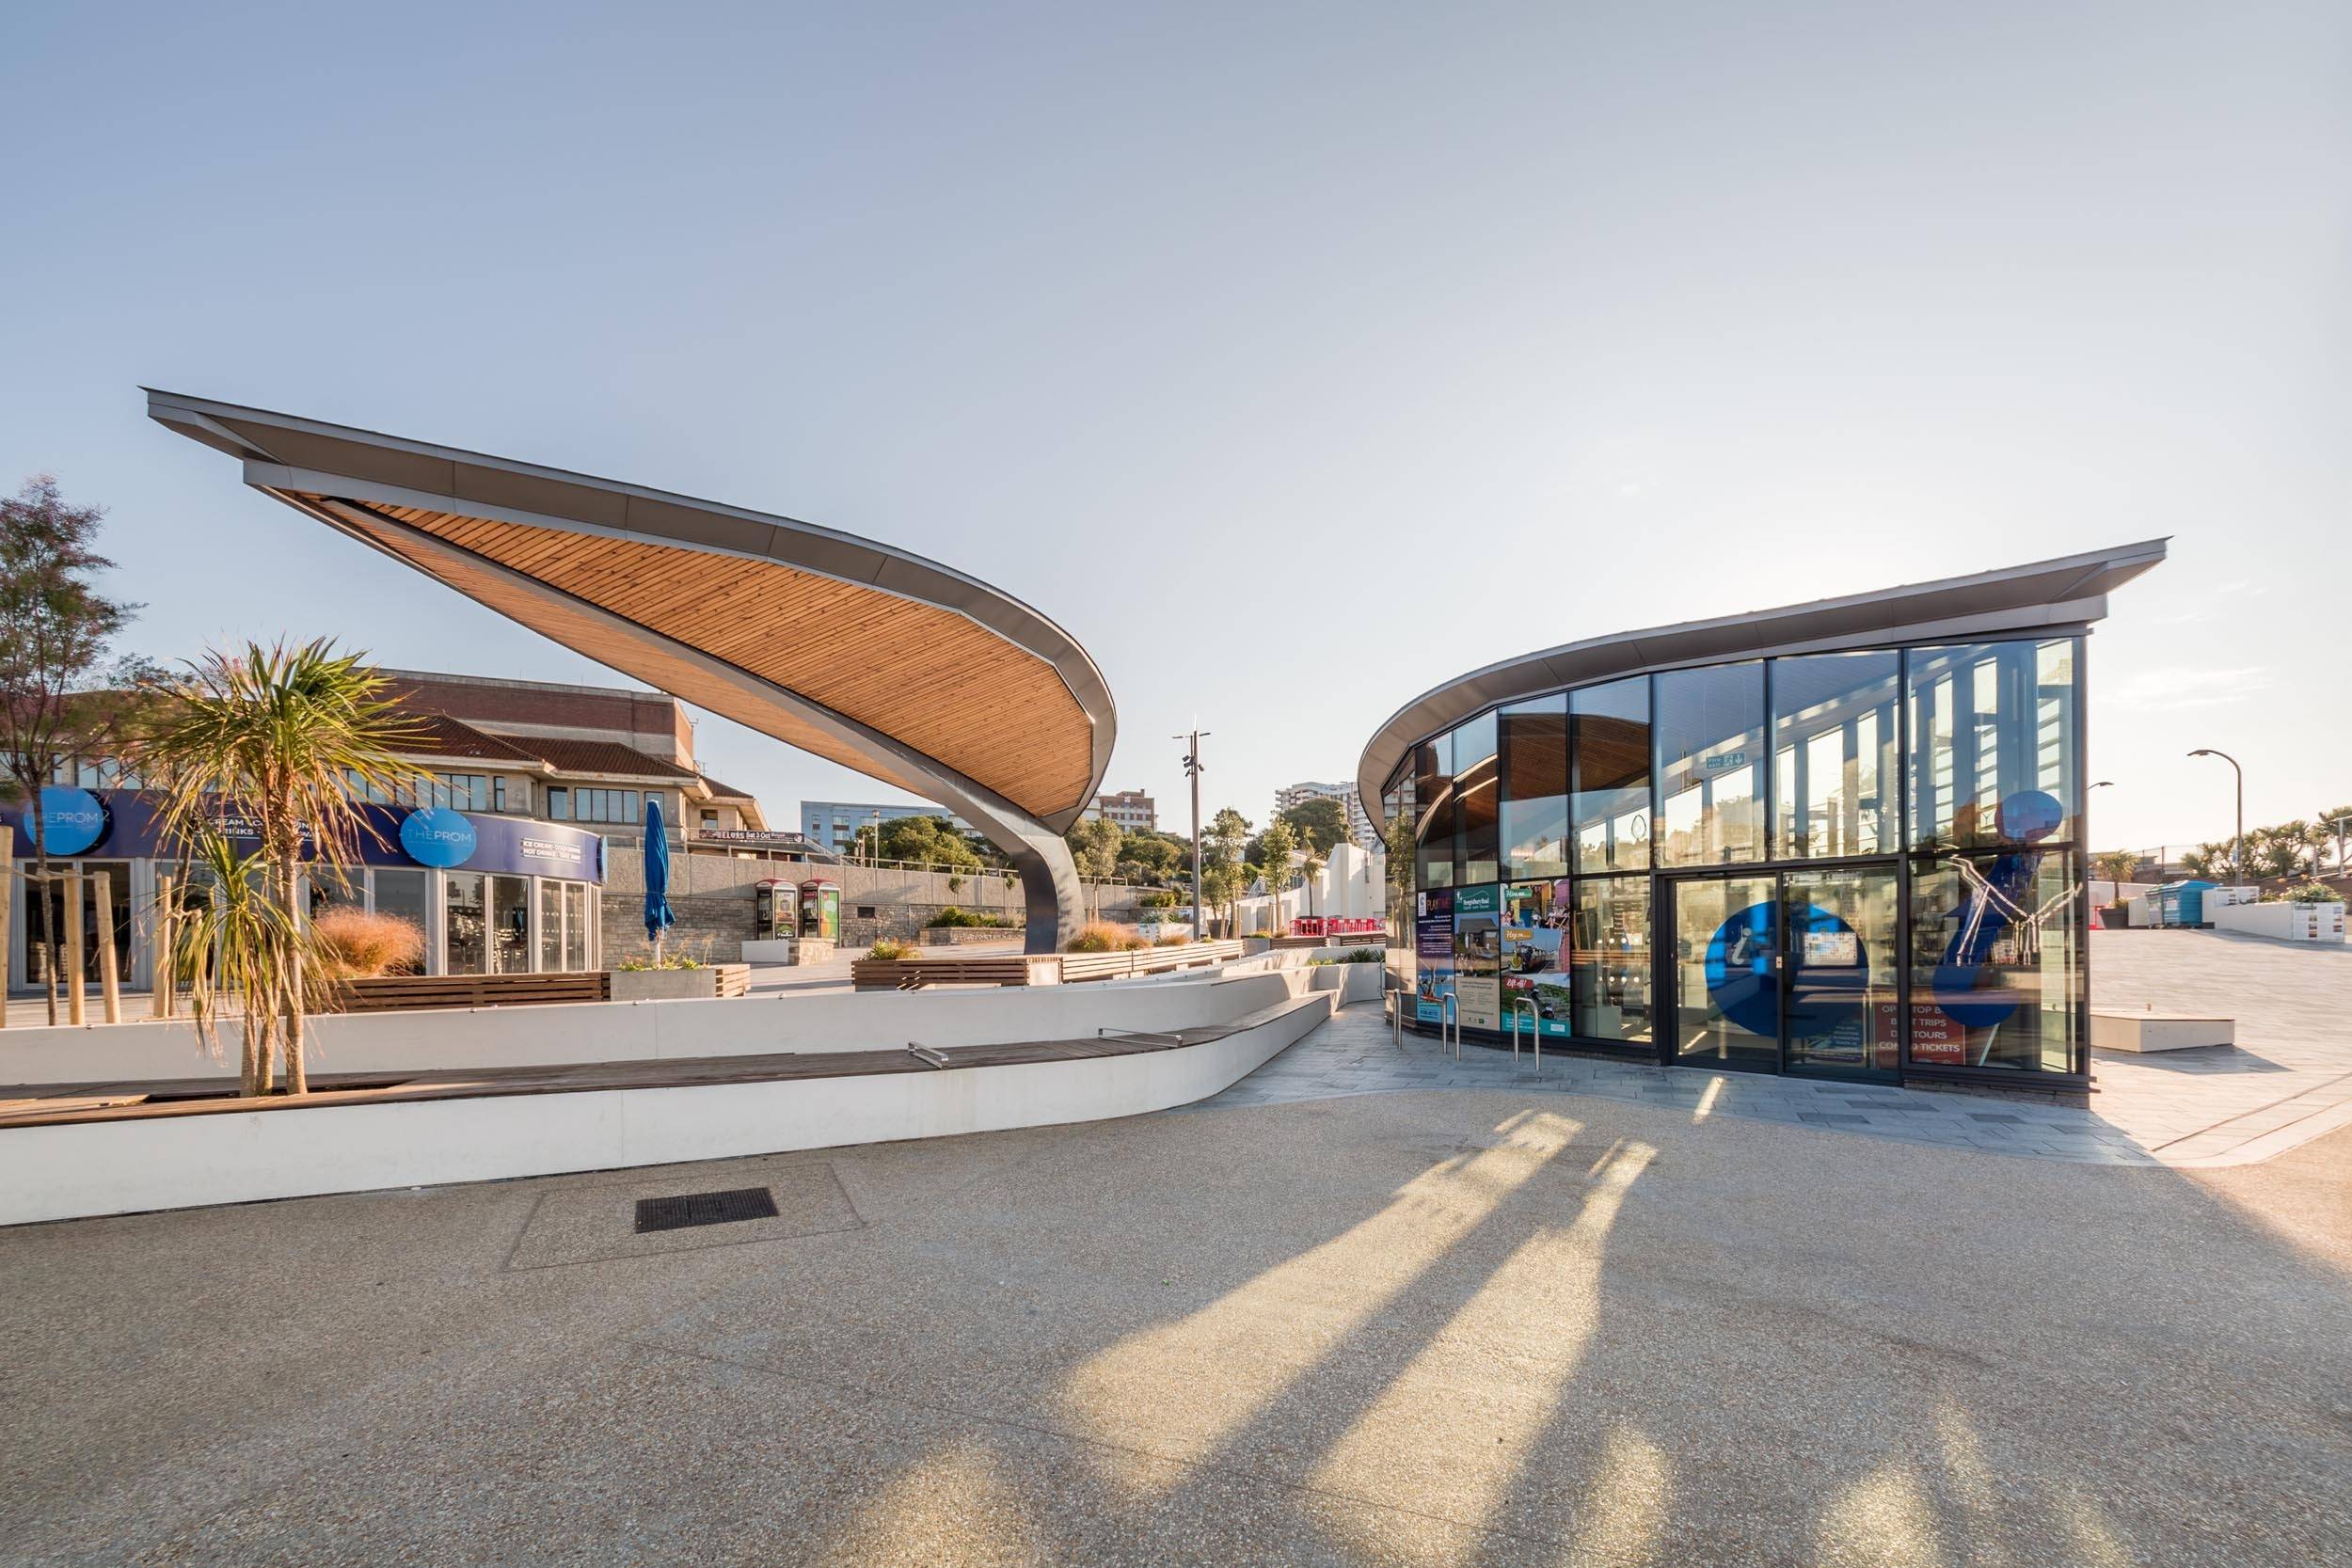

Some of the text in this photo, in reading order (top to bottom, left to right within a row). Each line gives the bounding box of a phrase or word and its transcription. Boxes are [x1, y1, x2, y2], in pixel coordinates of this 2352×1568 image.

[42, 813, 98, 823] EPROM
[1914, 1031, 1947, 1039] TOURS
[1920, 1043, 1960, 1053] TICKETS
